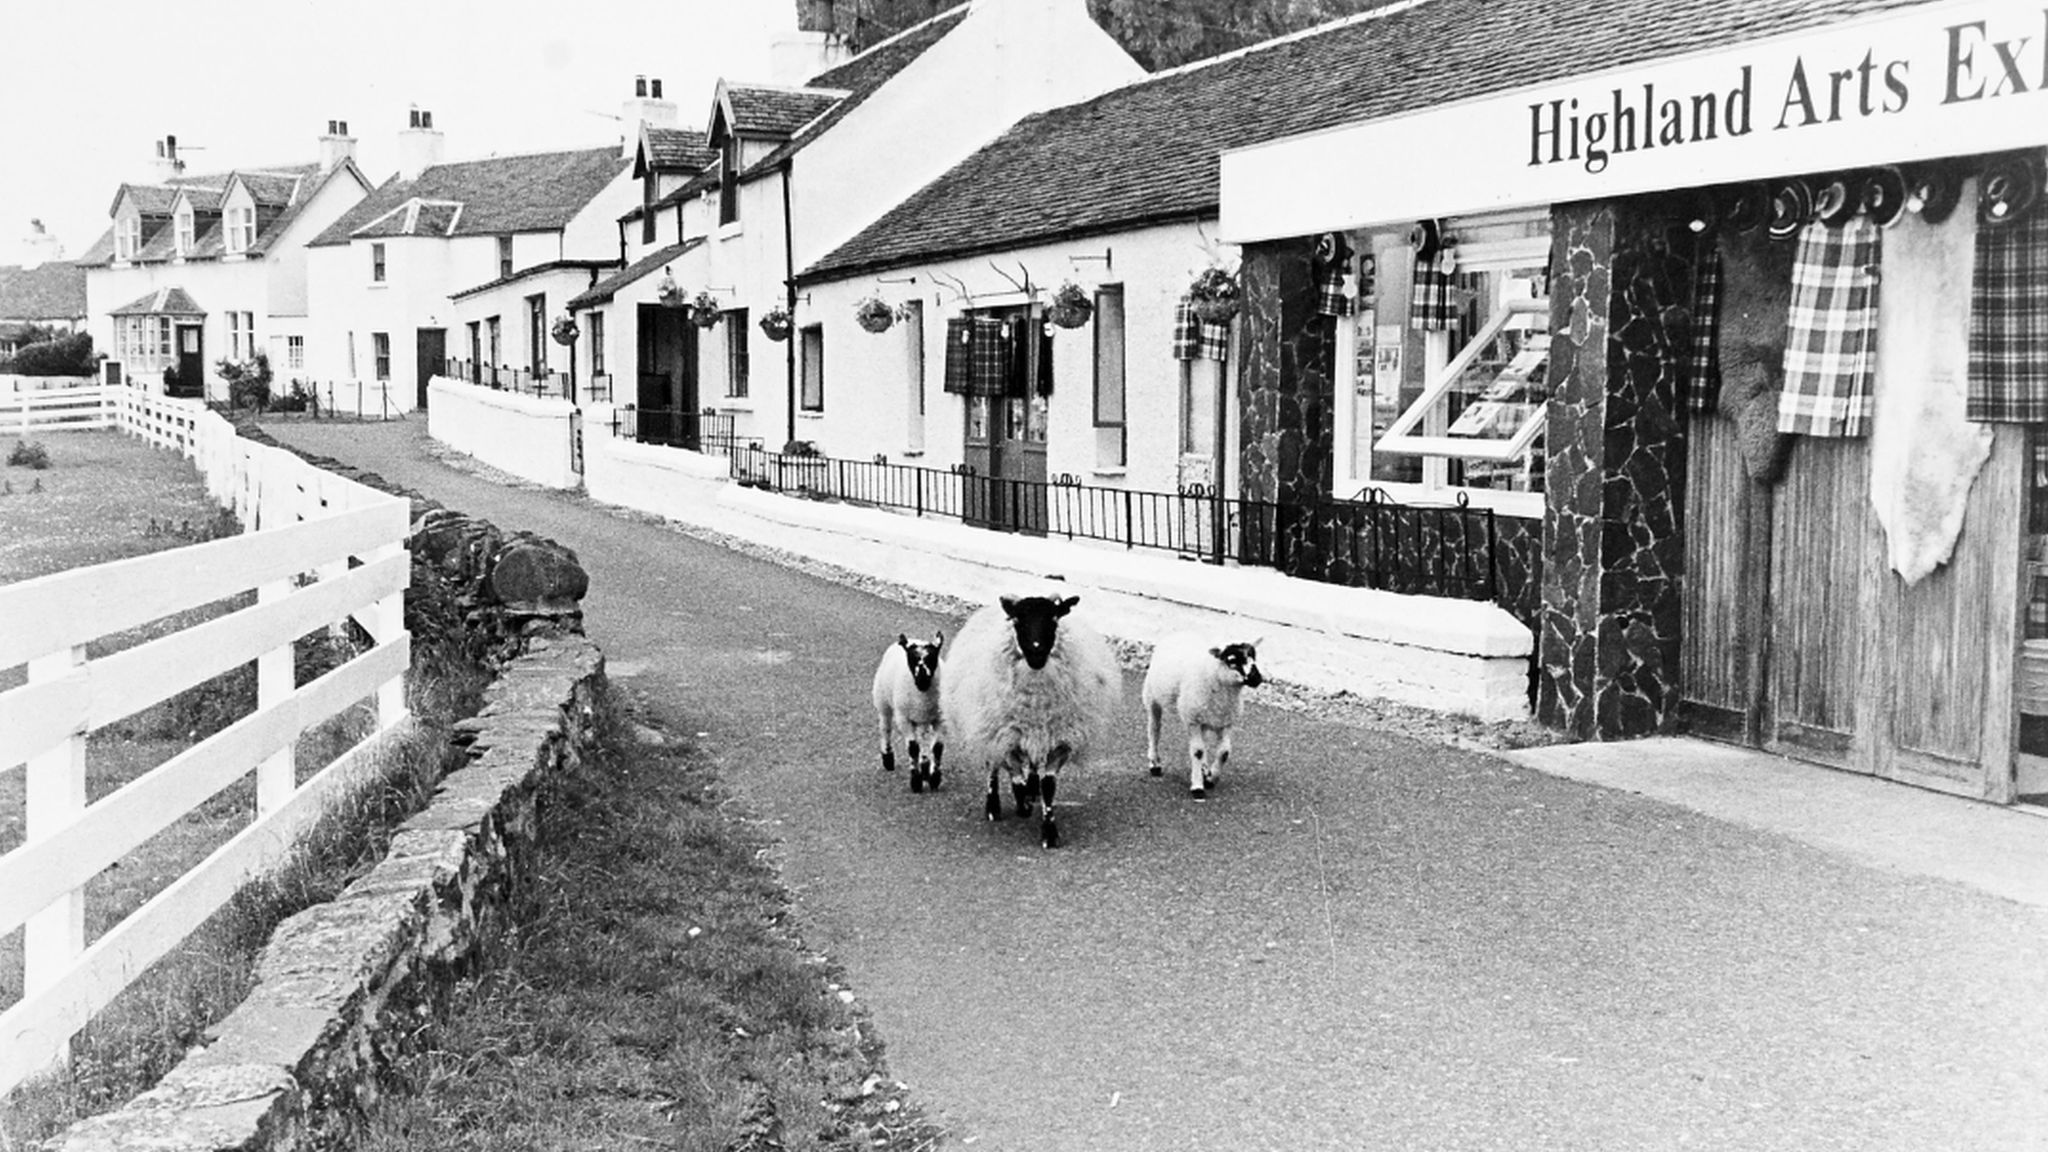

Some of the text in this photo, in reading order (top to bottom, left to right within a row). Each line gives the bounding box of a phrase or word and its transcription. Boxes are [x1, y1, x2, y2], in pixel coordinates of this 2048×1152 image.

[1528, 8, 2048, 174] Highland Arts Ex
